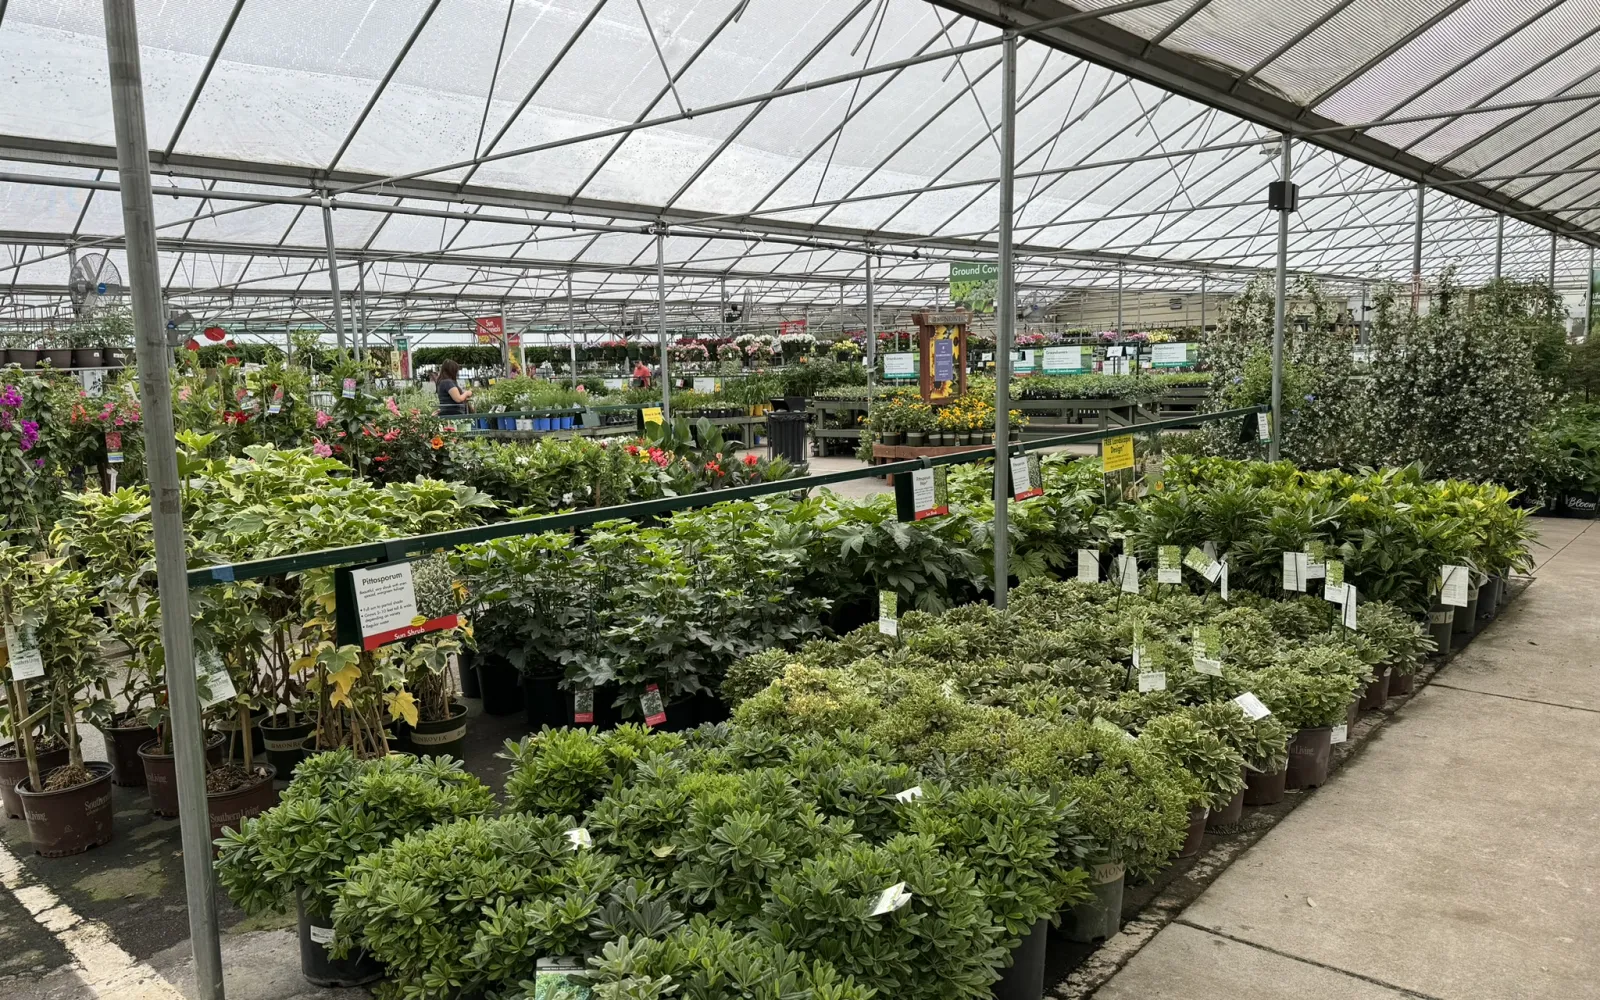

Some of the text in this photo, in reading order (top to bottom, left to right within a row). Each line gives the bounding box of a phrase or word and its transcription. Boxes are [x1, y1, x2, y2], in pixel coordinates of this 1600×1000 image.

[952, 264, 998, 276] Ground Cov
[1568, 496, 1596, 510] Bloom
[362, 573, 402, 586] Pittosporum
[407, 627, 425, 636] Shrub
[210, 811, 240, 823] Southern
[1098, 866, 1121, 880] MON
